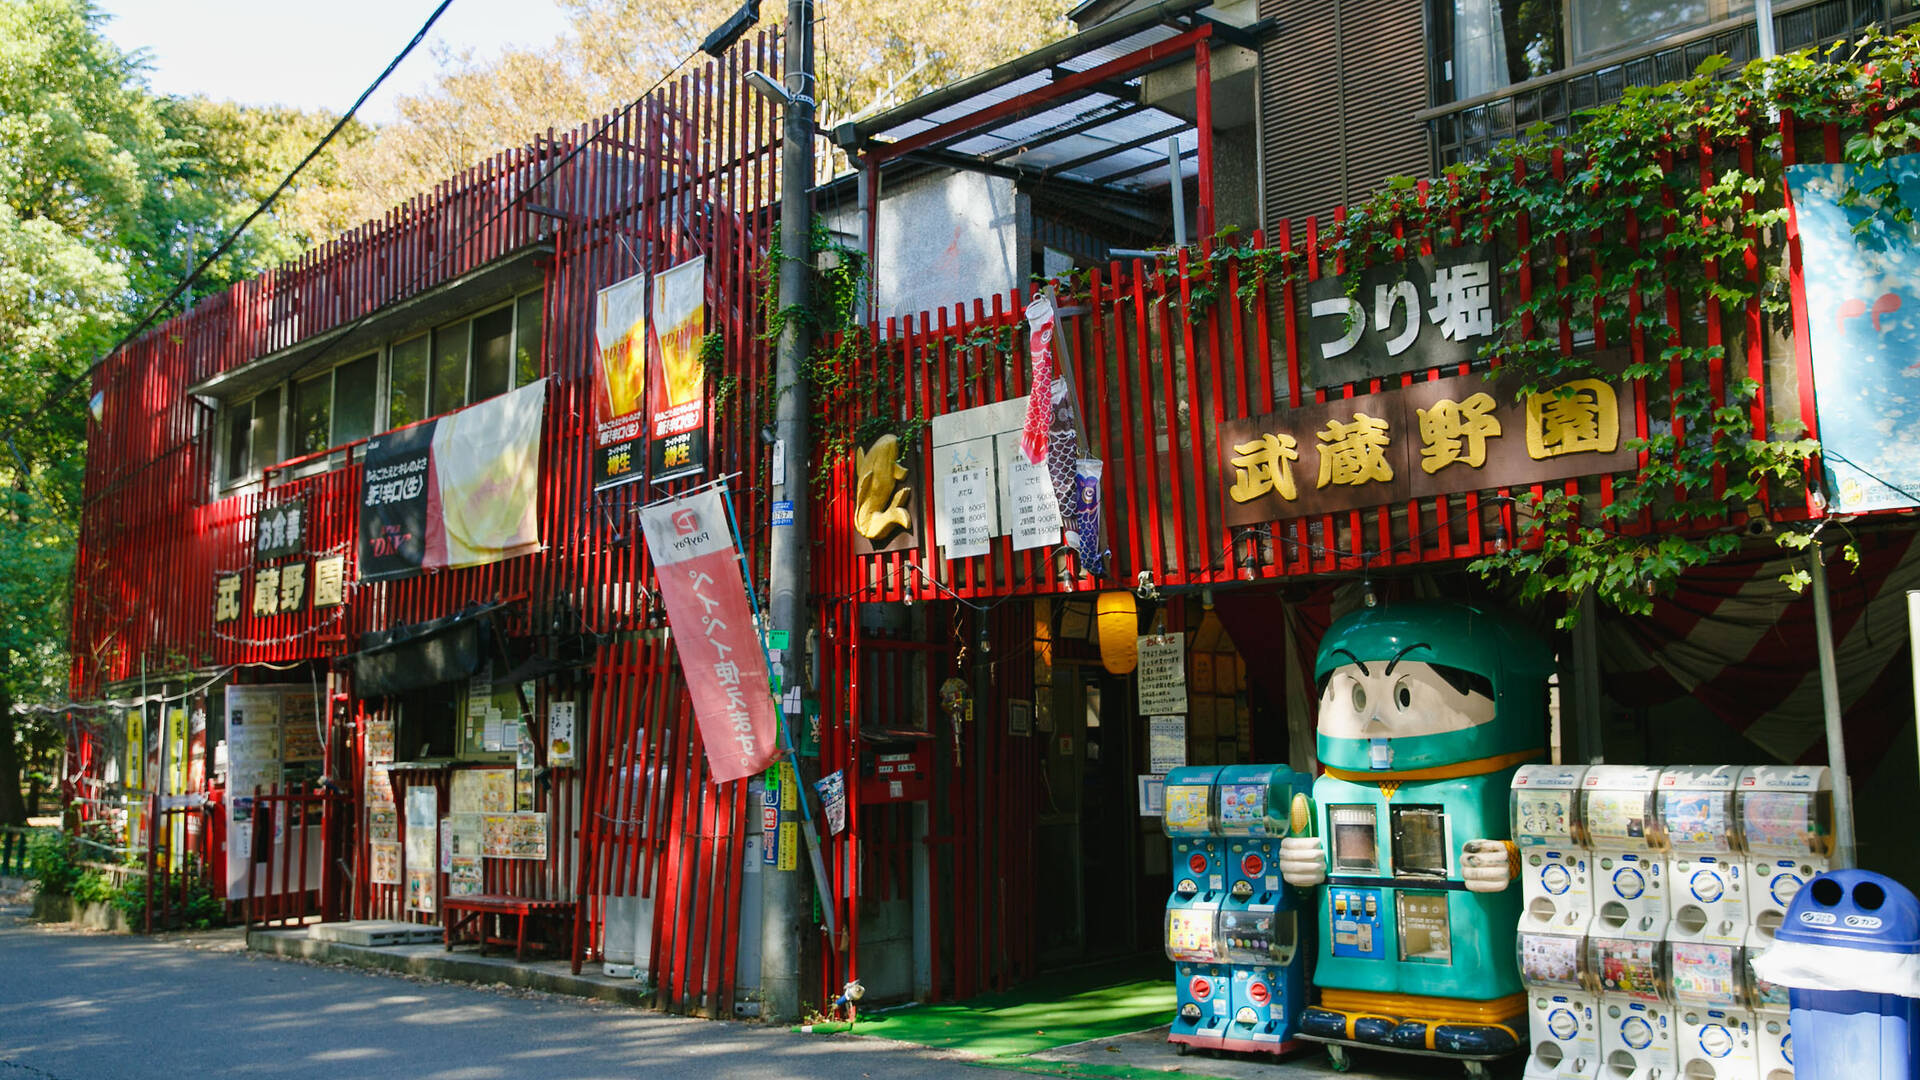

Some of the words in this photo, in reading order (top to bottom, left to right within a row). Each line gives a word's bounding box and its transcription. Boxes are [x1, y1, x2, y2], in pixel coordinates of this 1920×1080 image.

[1311, 260, 1493, 359] つり堀
[1229, 378, 1620, 504] 武蔵野園
[258, 509, 301, 552] お食事
[216, 553, 345, 622] 武蔵野園
